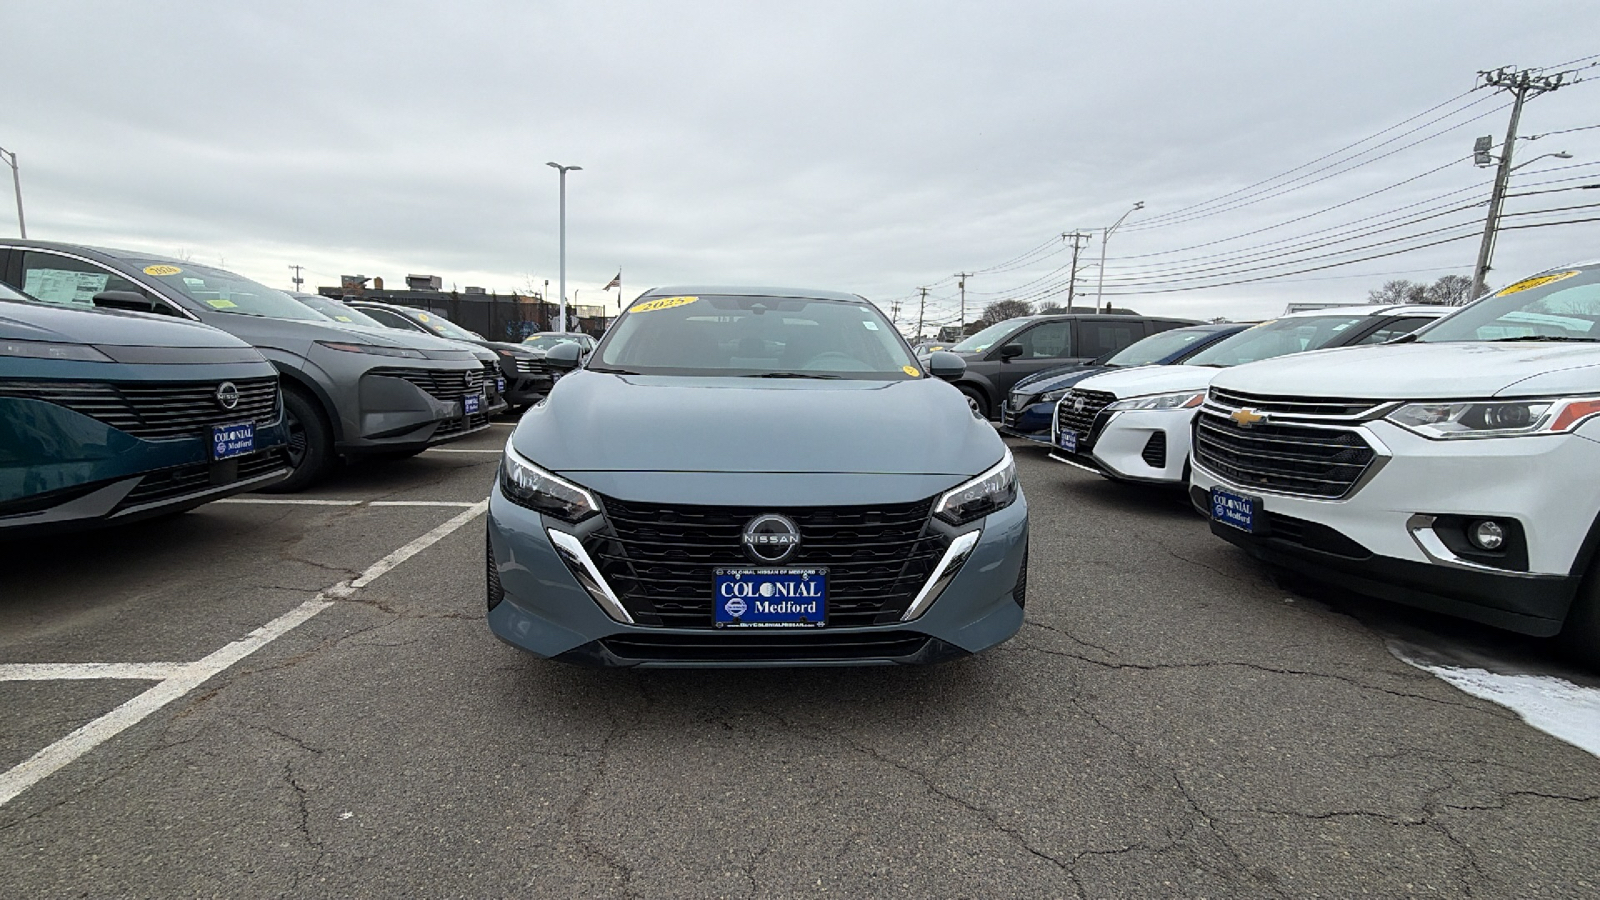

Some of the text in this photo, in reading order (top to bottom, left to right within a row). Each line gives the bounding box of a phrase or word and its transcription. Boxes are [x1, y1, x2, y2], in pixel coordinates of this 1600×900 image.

[643, 299, 685, 311] 2025
[214, 428, 253, 443] COLONIAL
[228, 439, 252, 450] Medford
[1213, 495, 1252, 515] COLONIAL
[1226, 509, 1251, 524] Medford
[744, 534, 799, 543] NISSAN
[720, 581, 822, 598] COLONIAL
[754, 601, 816, 614] Medford
